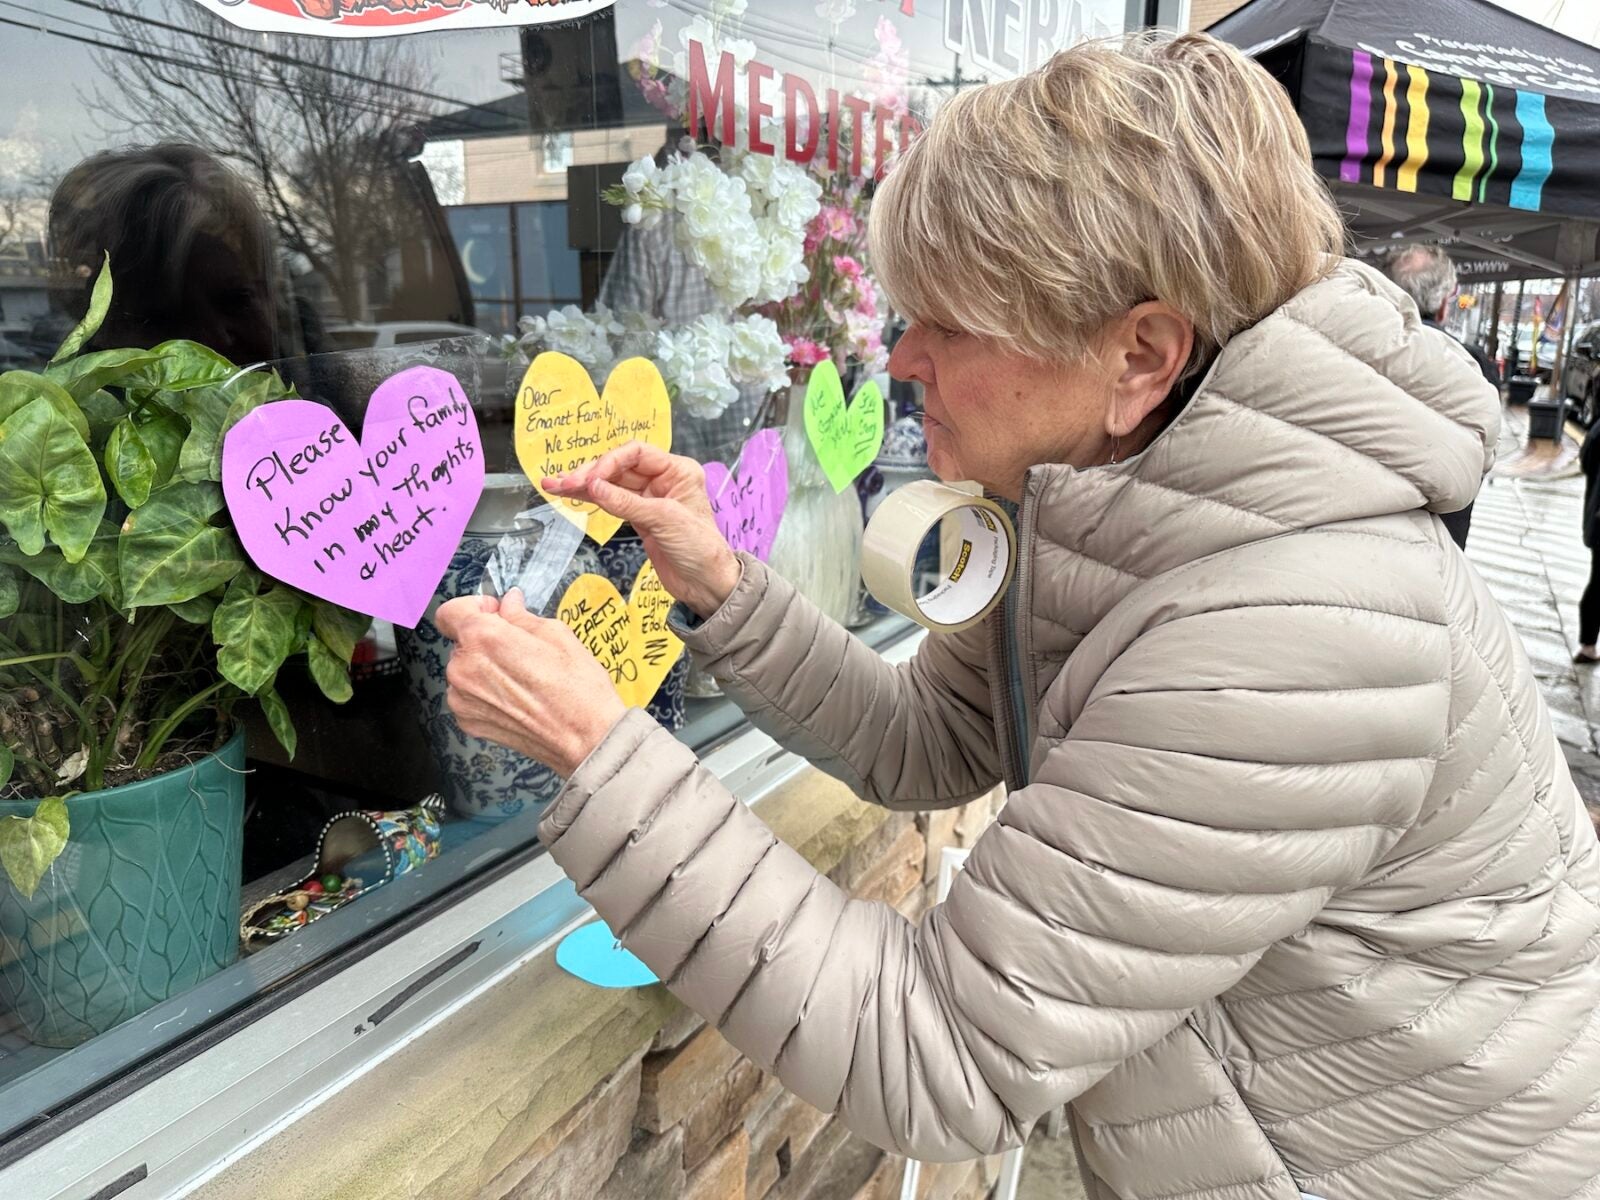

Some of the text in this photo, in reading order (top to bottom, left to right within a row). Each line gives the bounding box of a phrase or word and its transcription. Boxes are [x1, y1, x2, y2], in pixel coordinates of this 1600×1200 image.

[523, 386, 562, 410] Dear
[545, 434, 563, 455] We
[566, 426, 602, 450] stand
[246, 423, 345, 501] Please
[950, 542, 971, 582] Scotch
[561, 598, 592, 626] OUR
[572, 597, 616, 639] EARTS
